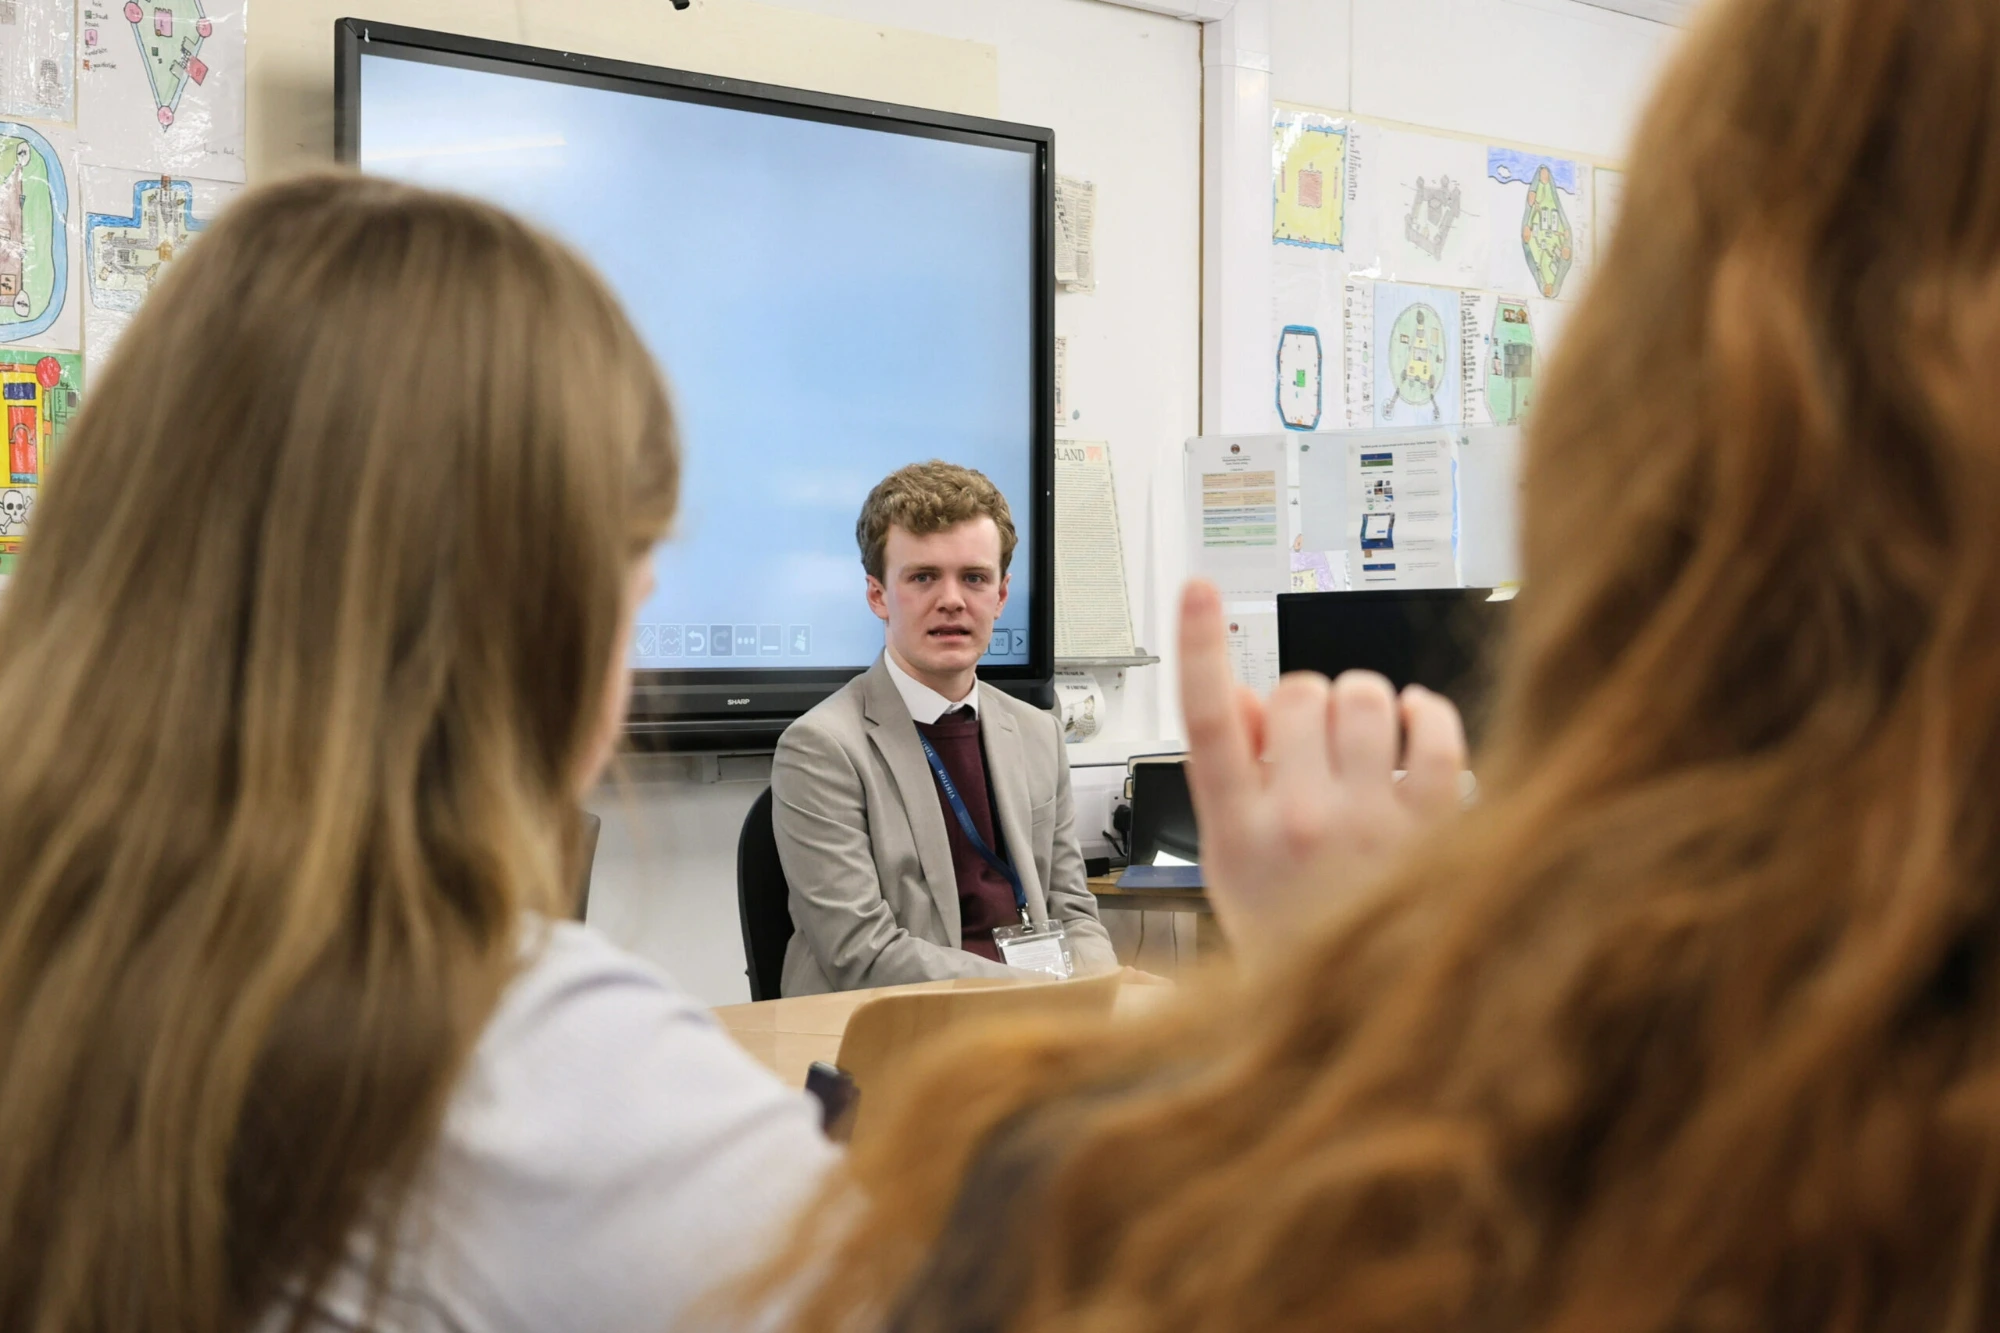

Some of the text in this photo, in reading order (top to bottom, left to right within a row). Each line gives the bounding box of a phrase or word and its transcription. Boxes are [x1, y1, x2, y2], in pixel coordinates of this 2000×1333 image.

[1054, 447, 1086, 462] LAND
[727, 698, 750, 706] SHARP
[938, 769, 955, 799] VISITOR
